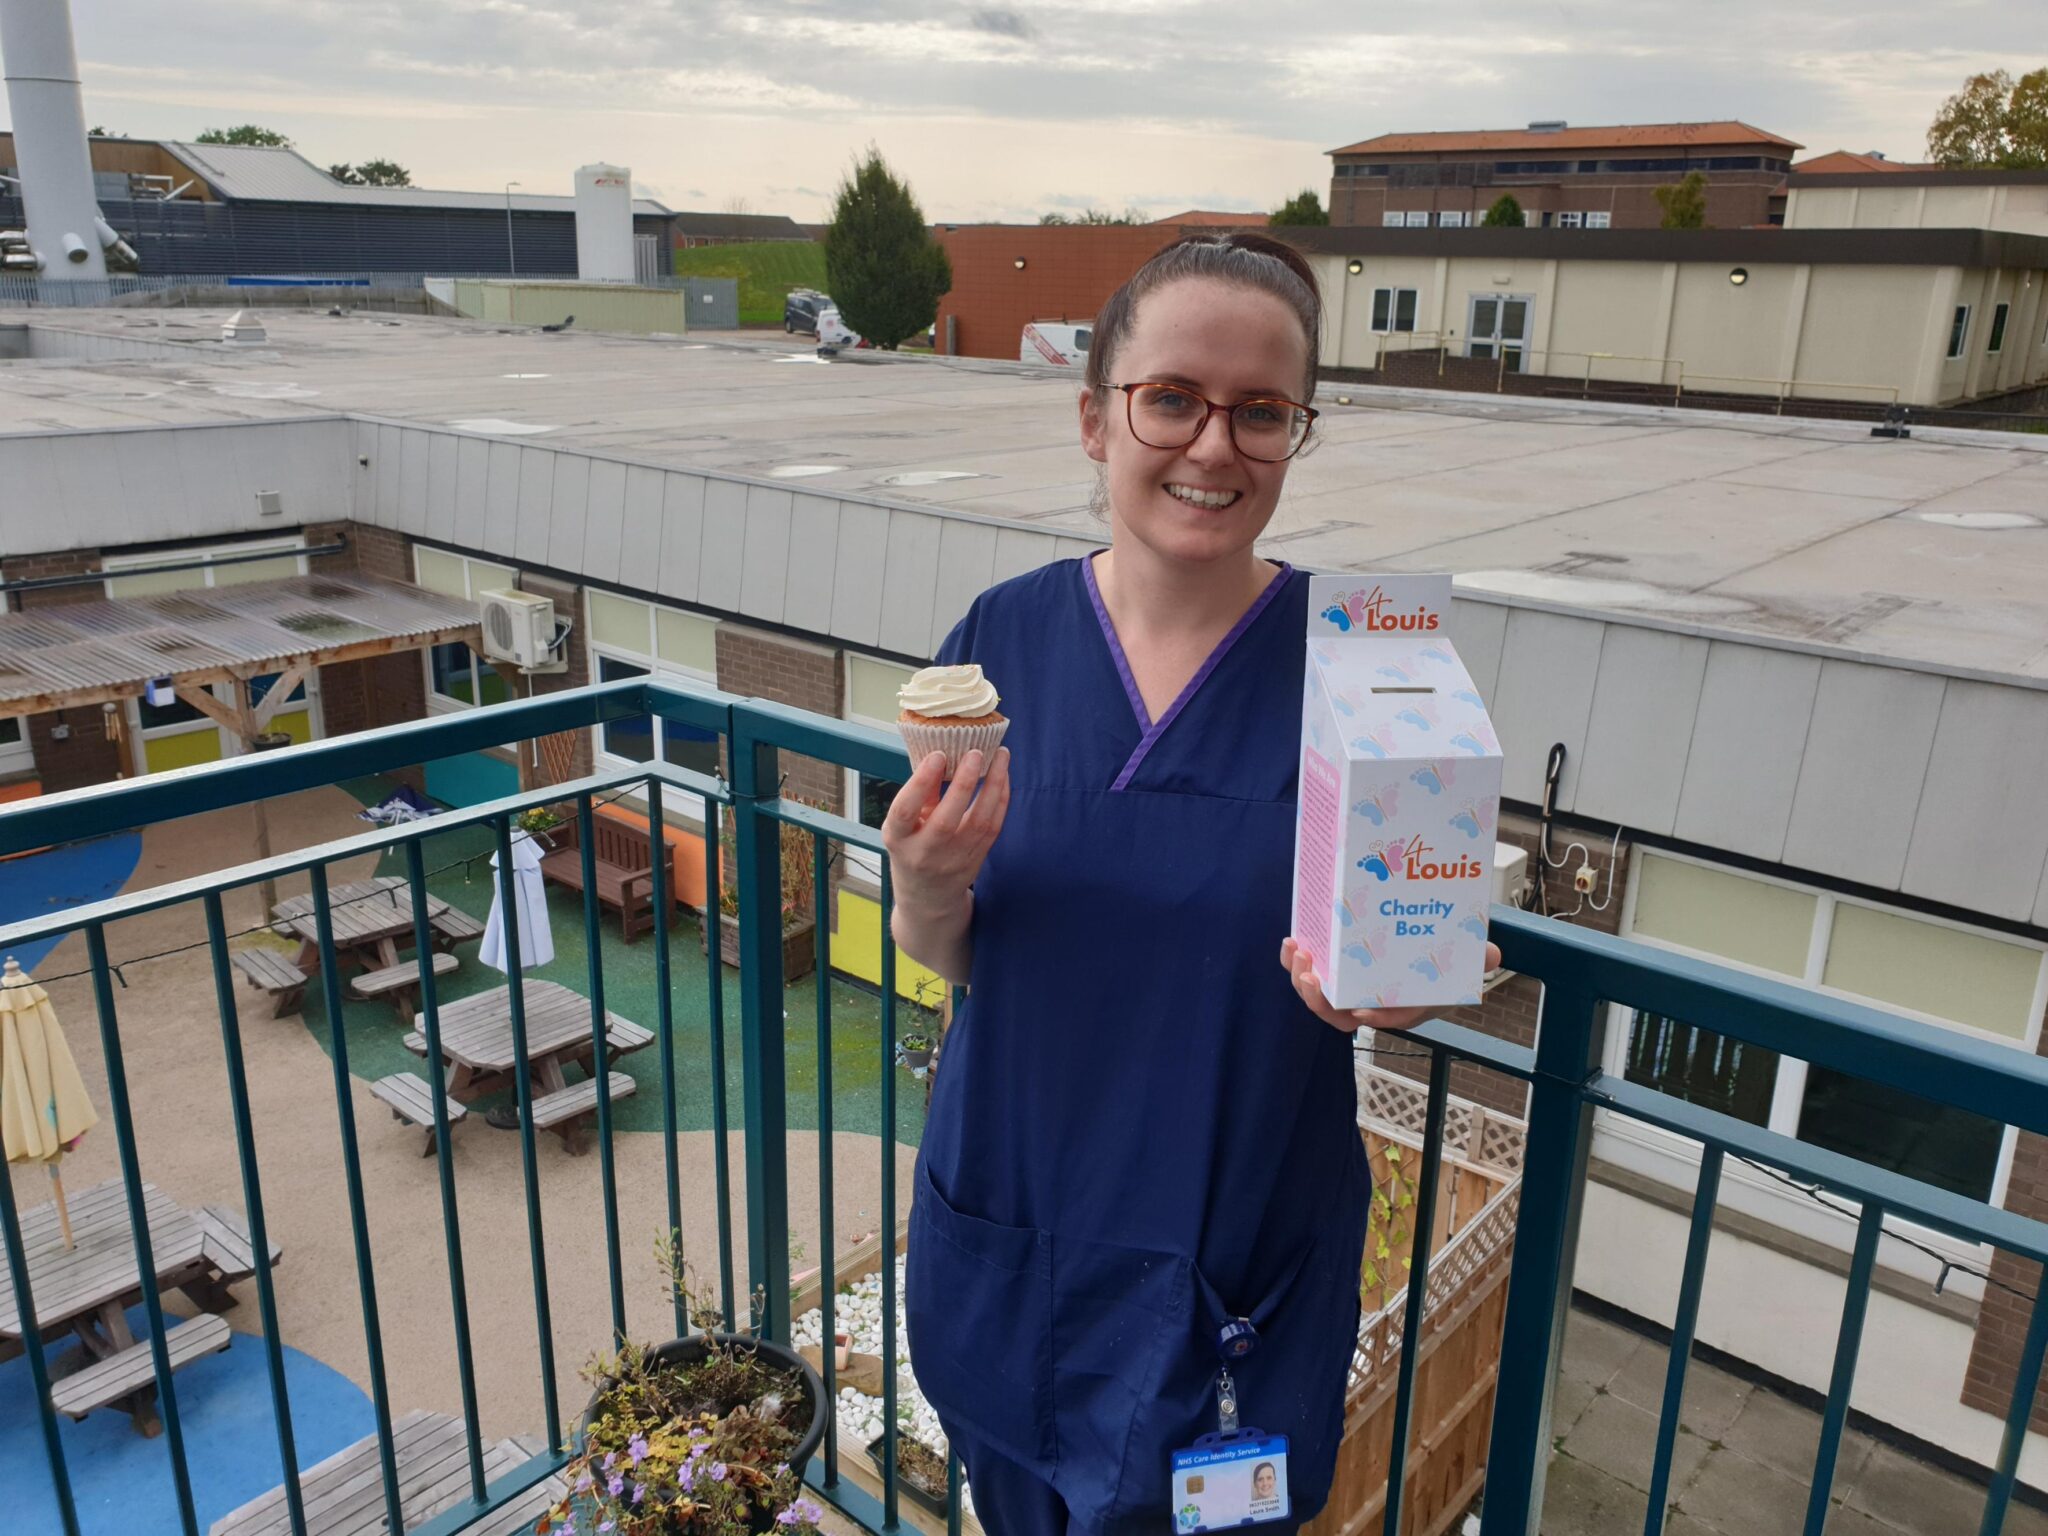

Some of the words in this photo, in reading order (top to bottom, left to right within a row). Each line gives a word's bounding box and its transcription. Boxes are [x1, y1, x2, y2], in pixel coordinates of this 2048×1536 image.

[1362, 585, 1393, 618] 4
[1367, 606, 1439, 631] Louis
[1402, 834, 1434, 867] 4
[1407, 854, 1482, 880] Louis
[1380, 898, 1455, 919] Charity
[1395, 920, 1436, 936] Box
[1178, 1457, 1193, 1466] NHS
[1194, 1454, 1209, 1463] Care
[1210, 1450, 1236, 1460] Identity
[1237, 1447, 1261, 1457] Service
